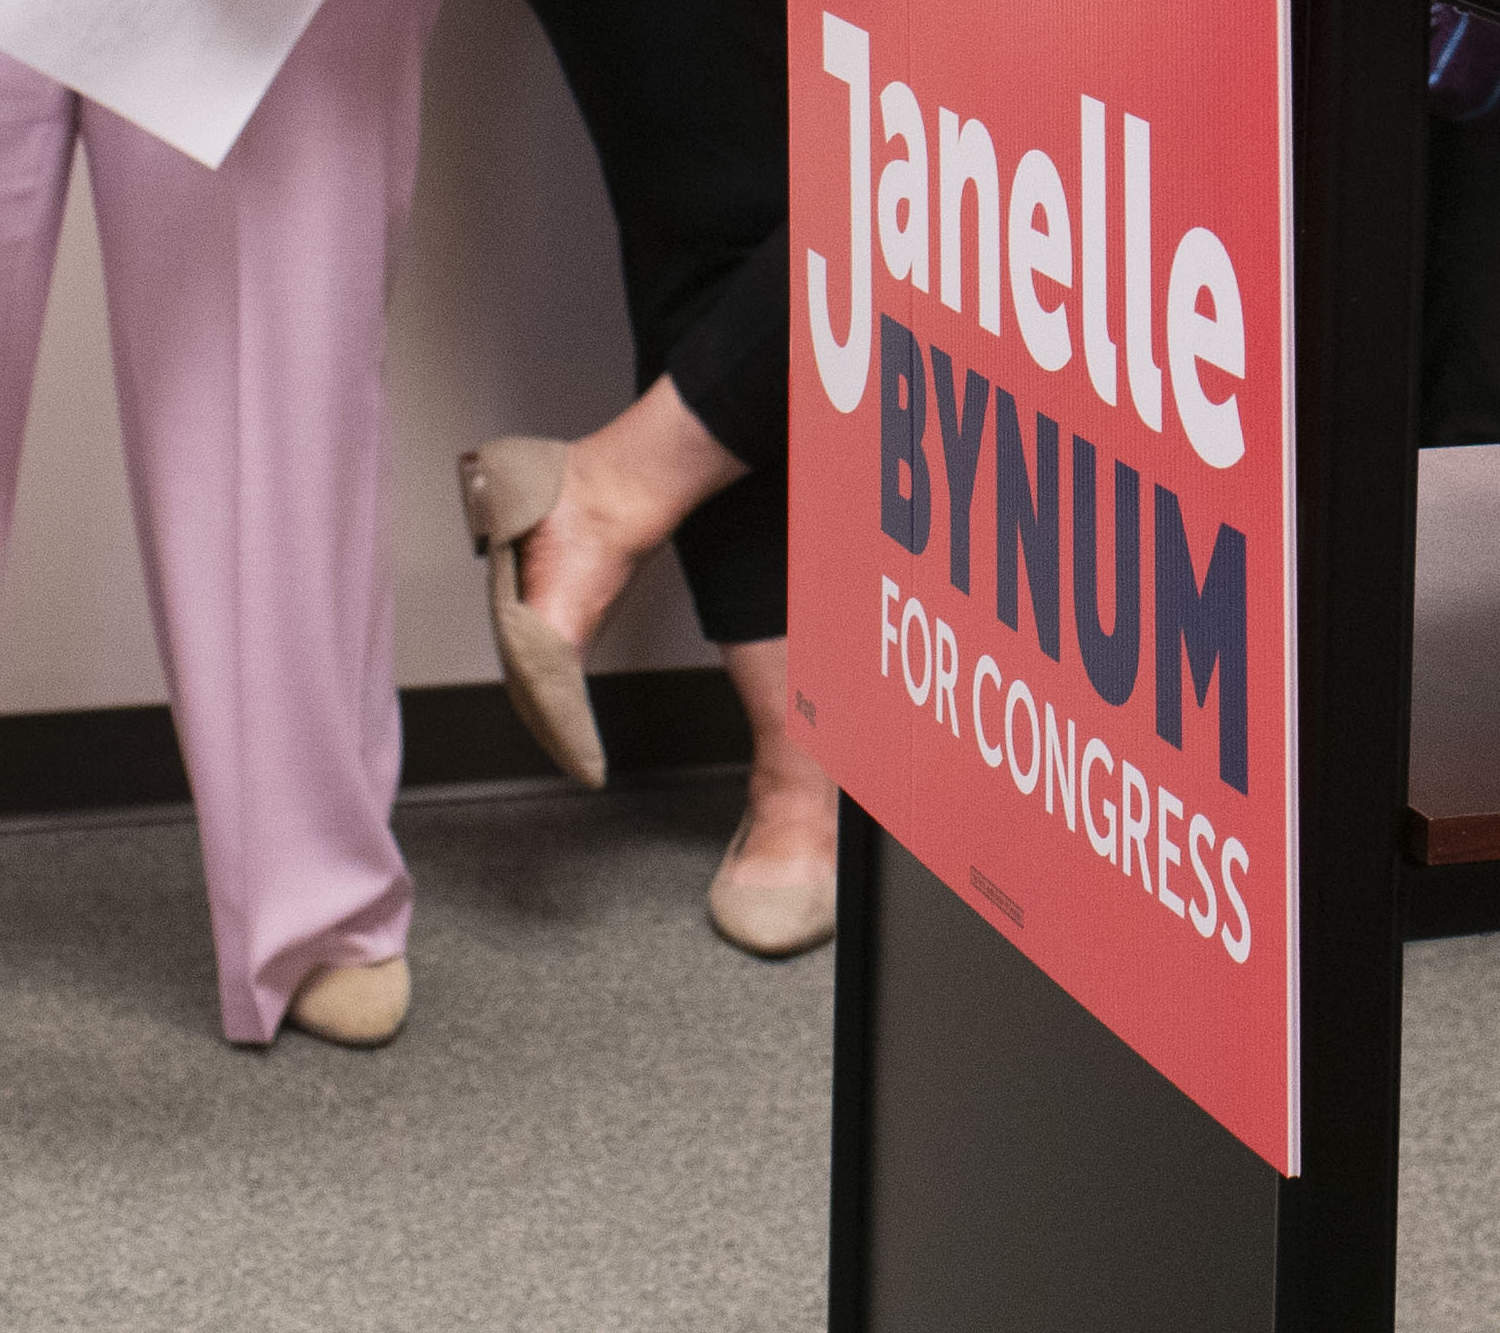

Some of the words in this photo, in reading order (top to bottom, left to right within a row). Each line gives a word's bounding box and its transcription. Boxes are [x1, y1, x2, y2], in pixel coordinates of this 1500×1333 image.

[880, 312, 1248, 796] BYNUM
[880, 574, 962, 738] FOR
[972, 651, 1251, 965] CONGRESS
